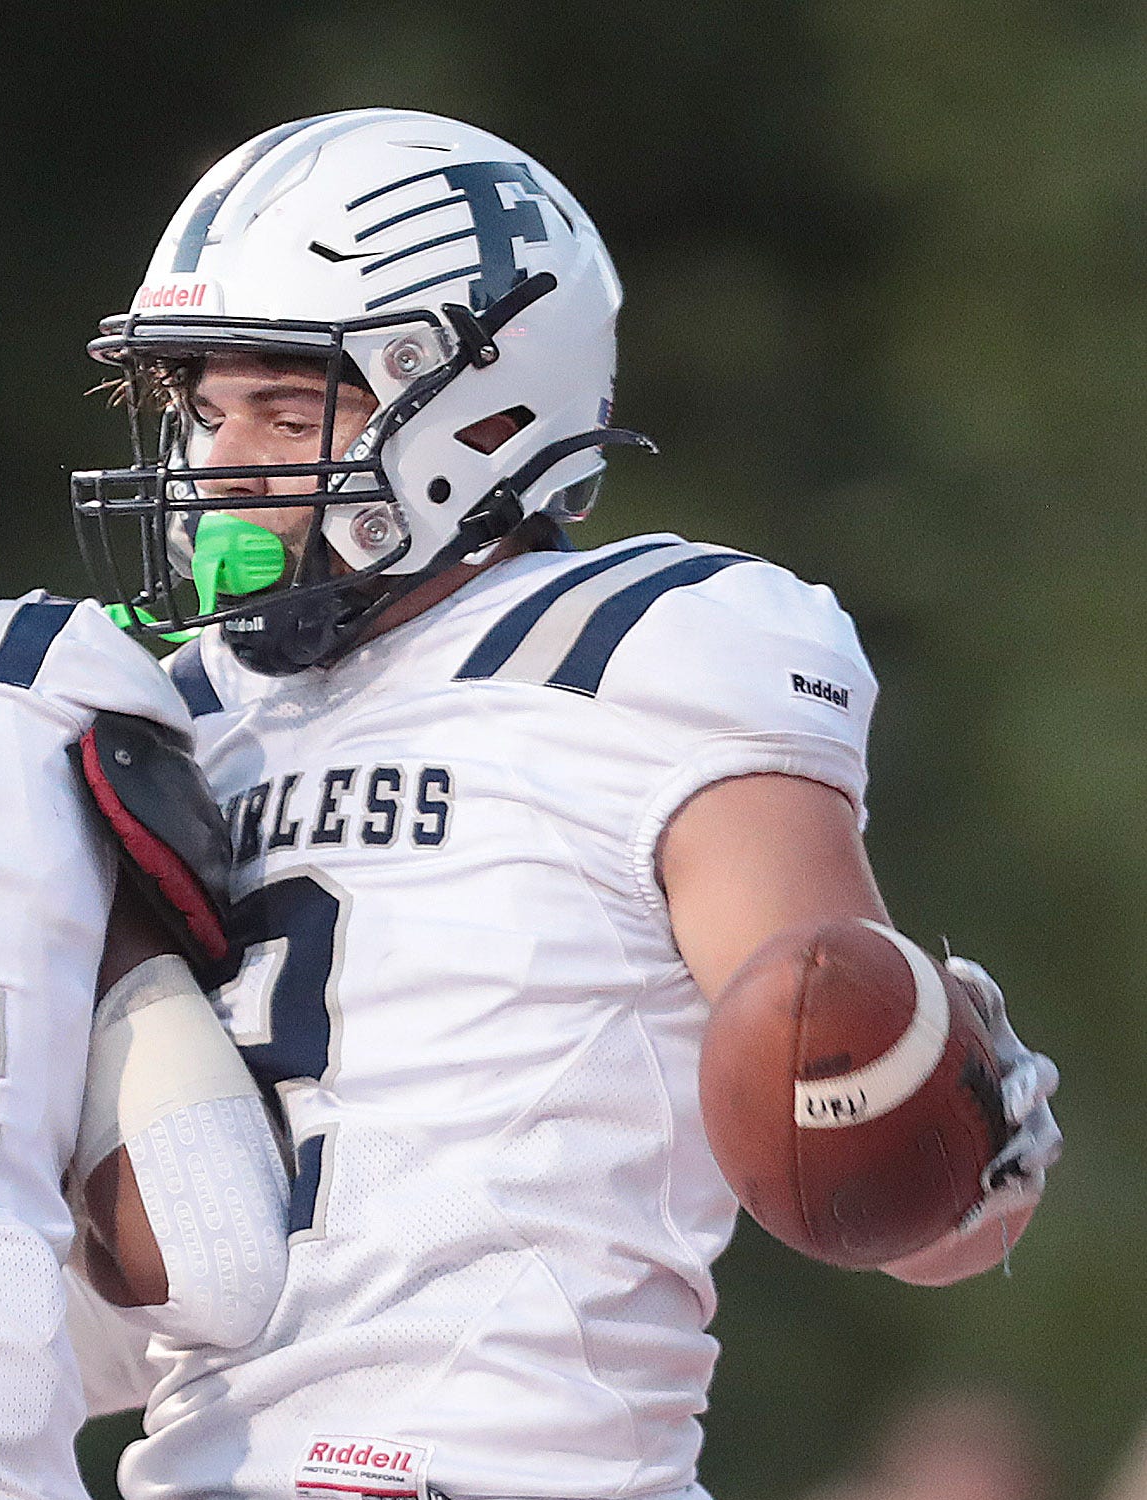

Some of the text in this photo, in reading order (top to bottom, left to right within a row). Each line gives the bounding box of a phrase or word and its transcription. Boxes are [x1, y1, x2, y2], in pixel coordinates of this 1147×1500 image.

[791, 673, 848, 708] Riddell
[308, 1442, 412, 1473] Riddell
[360, 1471, 405, 1482] PERFORM
